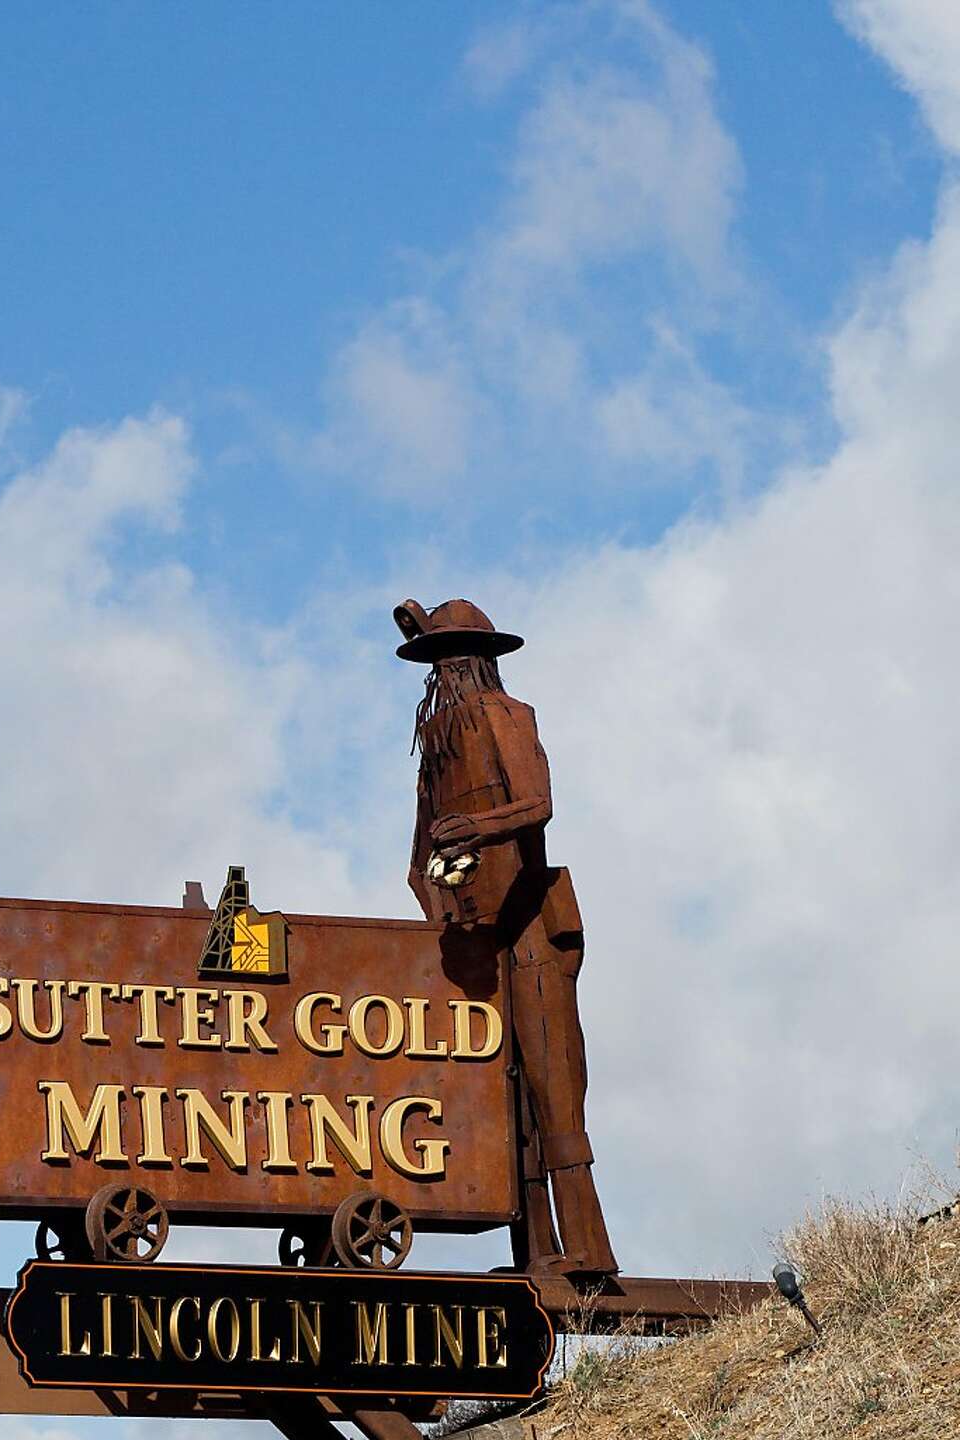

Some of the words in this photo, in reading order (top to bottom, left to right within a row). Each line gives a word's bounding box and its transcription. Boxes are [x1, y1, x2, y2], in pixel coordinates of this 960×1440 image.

[294, 991, 503, 1060] GOLD
[38, 1080, 451, 1176] MINING
[54, 1291, 325, 1365] LINCOLN
[349, 1300, 509, 1368] MINE
